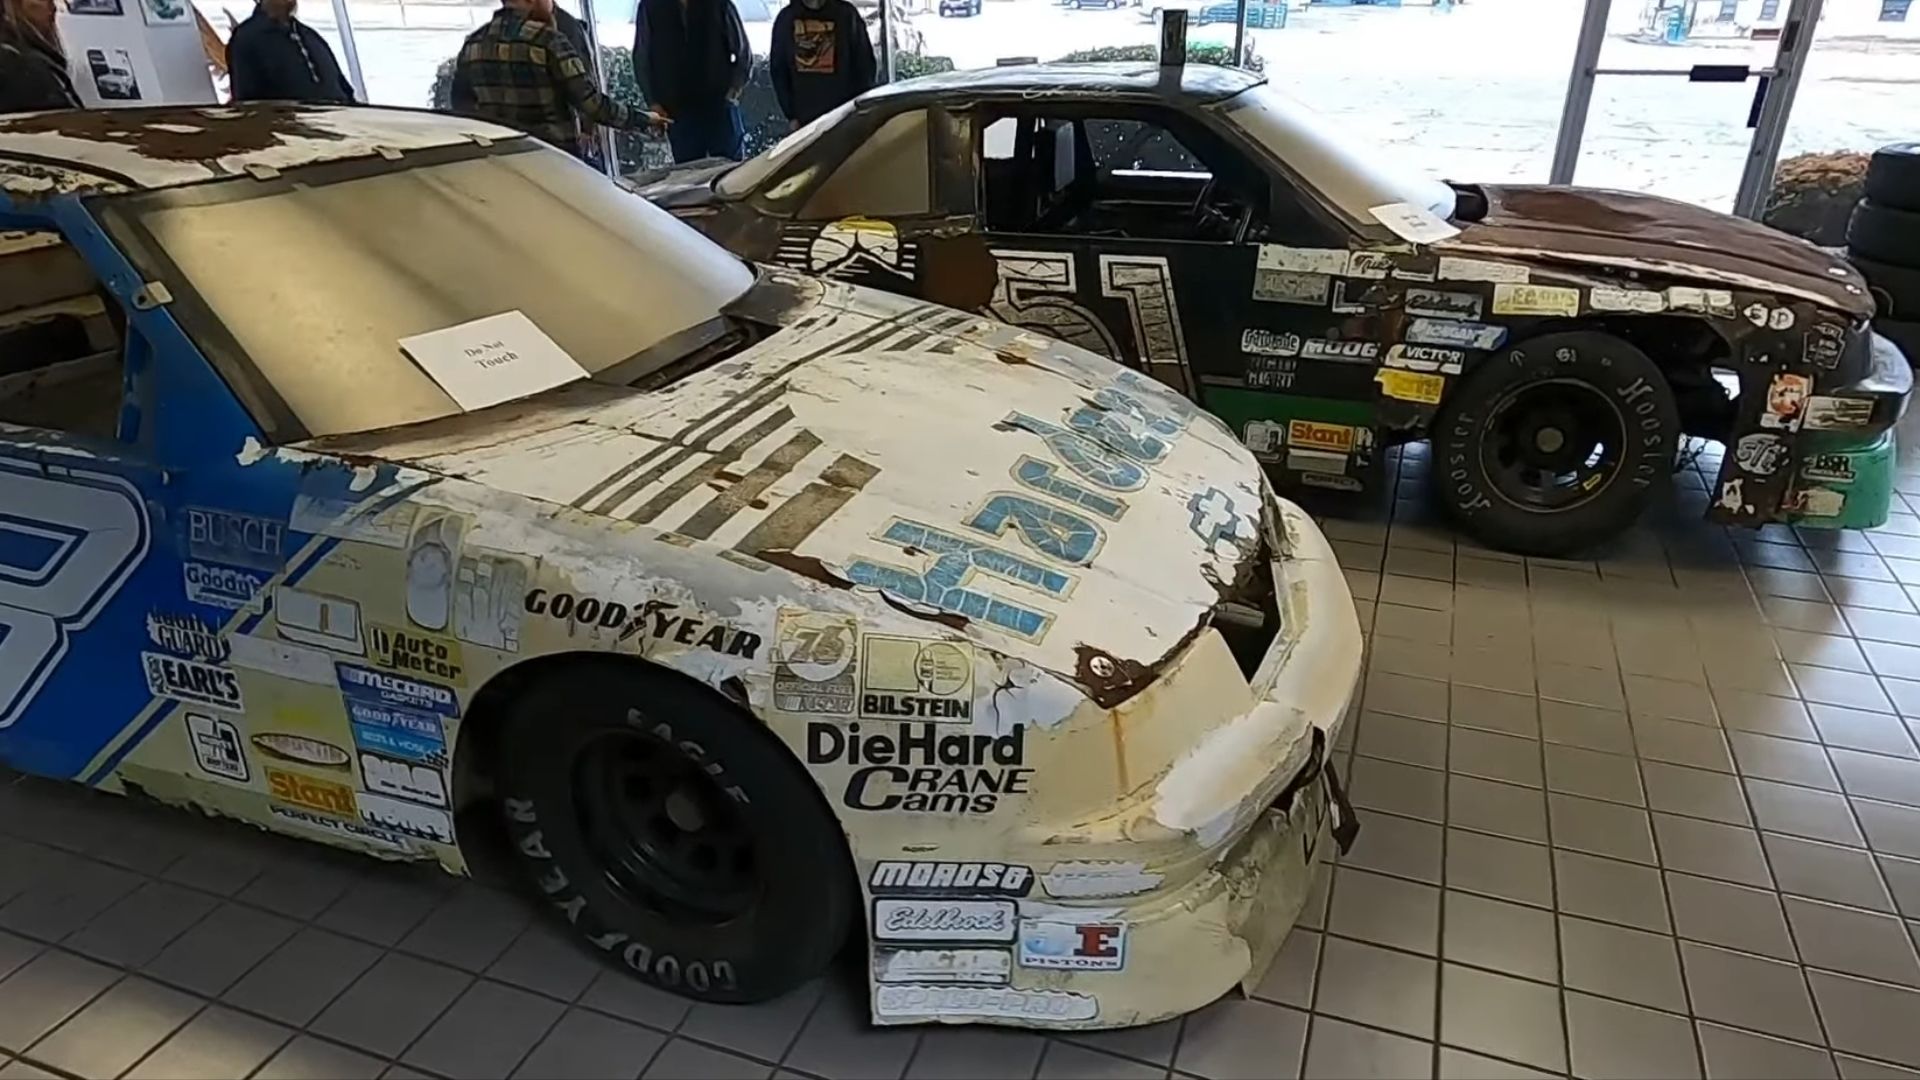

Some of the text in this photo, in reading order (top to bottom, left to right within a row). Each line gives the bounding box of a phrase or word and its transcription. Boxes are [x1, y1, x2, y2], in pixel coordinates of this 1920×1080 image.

[988, 249, 1197, 402] 51
[463, 348, 483, 357] Do
[474, 351, 519, 368] Touch
[1406, 345, 1462, 363] VICTOR
[1291, 422, 1351, 444] Stant
[1617, 377, 1662, 488] Hoosier
[189, 510, 283, 555] BUSCH
[393, 631, 448, 660] Auto
[788, 625, 851, 664] 76
[162, 658, 241, 698] EARL'S
[392, 649, 462, 679] Meter
[864, 694, 970, 719] BILSTEIN
[807, 722, 1023, 766] DieHard
[269, 771, 355, 814] Stant
[885, 906, 1006, 932] Edelbrock
